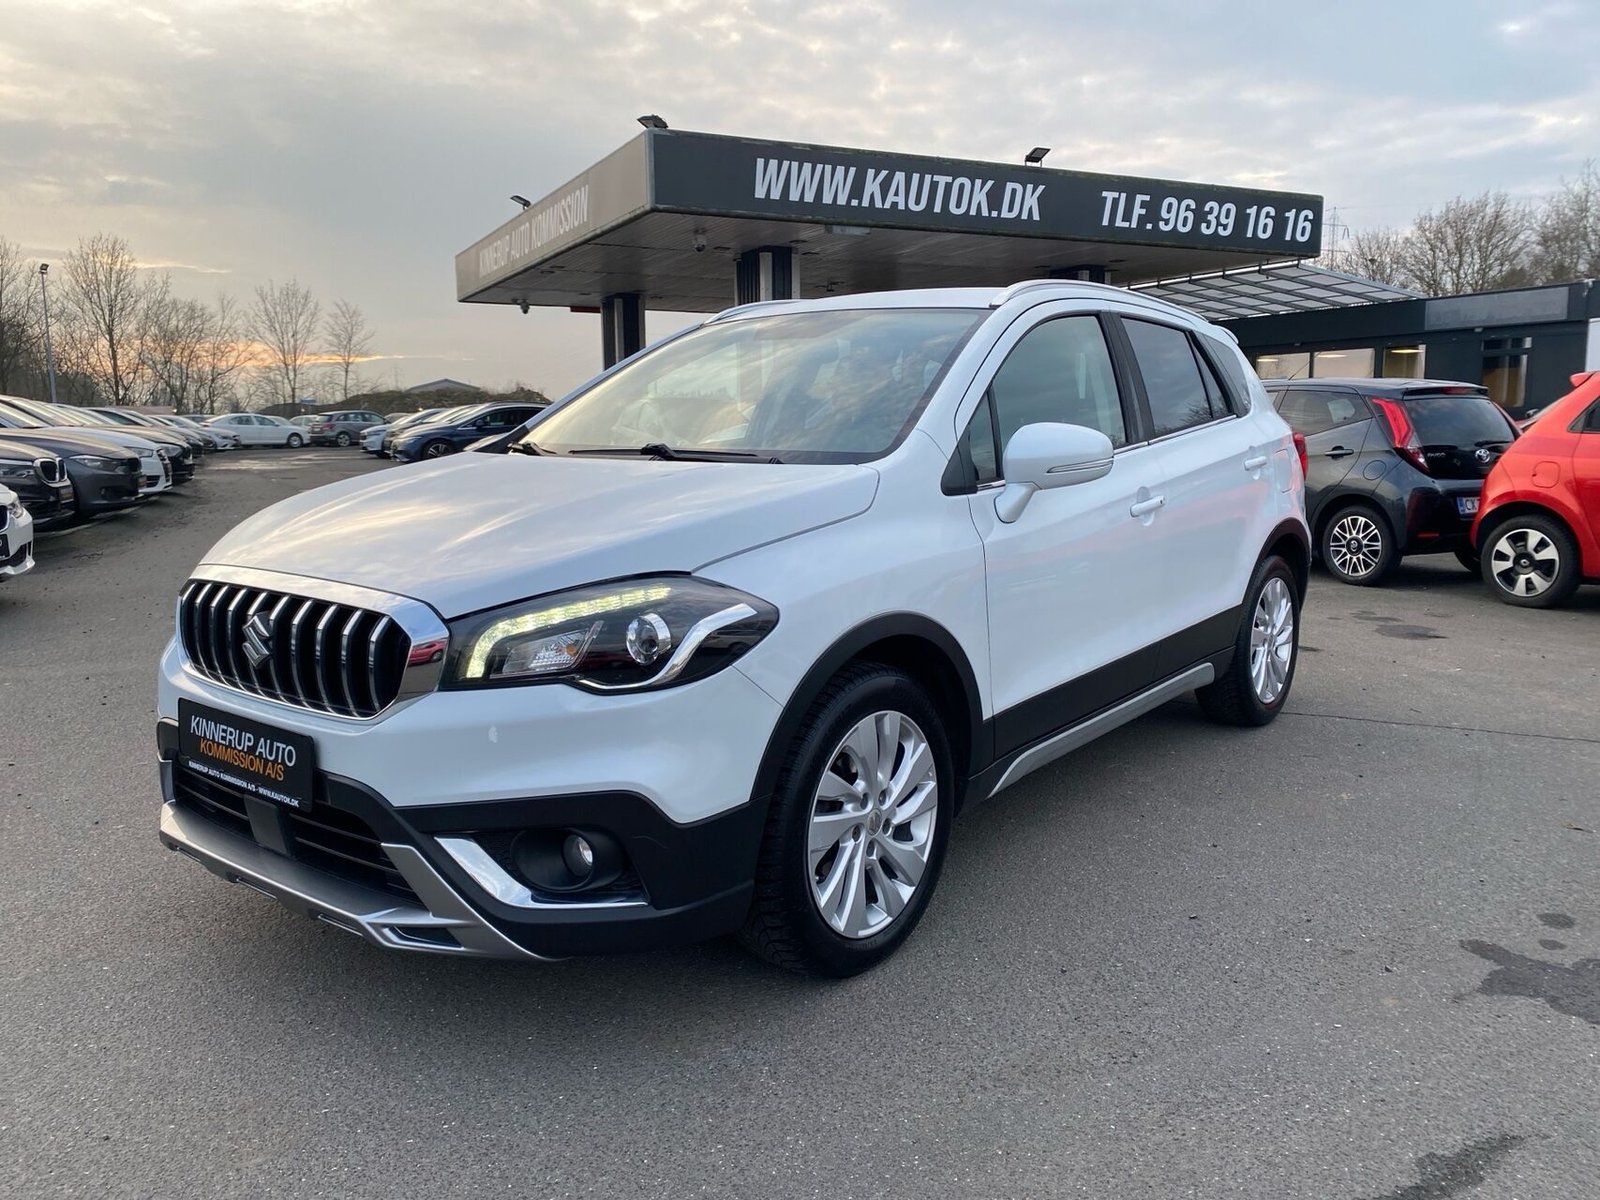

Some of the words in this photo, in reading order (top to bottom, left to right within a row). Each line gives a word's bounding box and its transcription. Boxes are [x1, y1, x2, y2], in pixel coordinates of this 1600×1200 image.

[754, 158, 1046, 221] WWW.KAUTOK.DK
[510, 222, 530, 261] AUTO
[531, 184, 589, 250] KOMMISSION
[1101, 191, 1153, 230] TLF.
[1158, 197, 1196, 233] 96
[1201, 201, 1237, 237] 39
[1246, 205, 1276, 240] 16
[1284, 208, 1314, 243] 16
[190, 715, 254, 752] KINNERUP
[256, 738, 296, 767] AUTO
[200, 739, 263, 774] KOMMISSION
[265, 762, 284, 781] A/S
